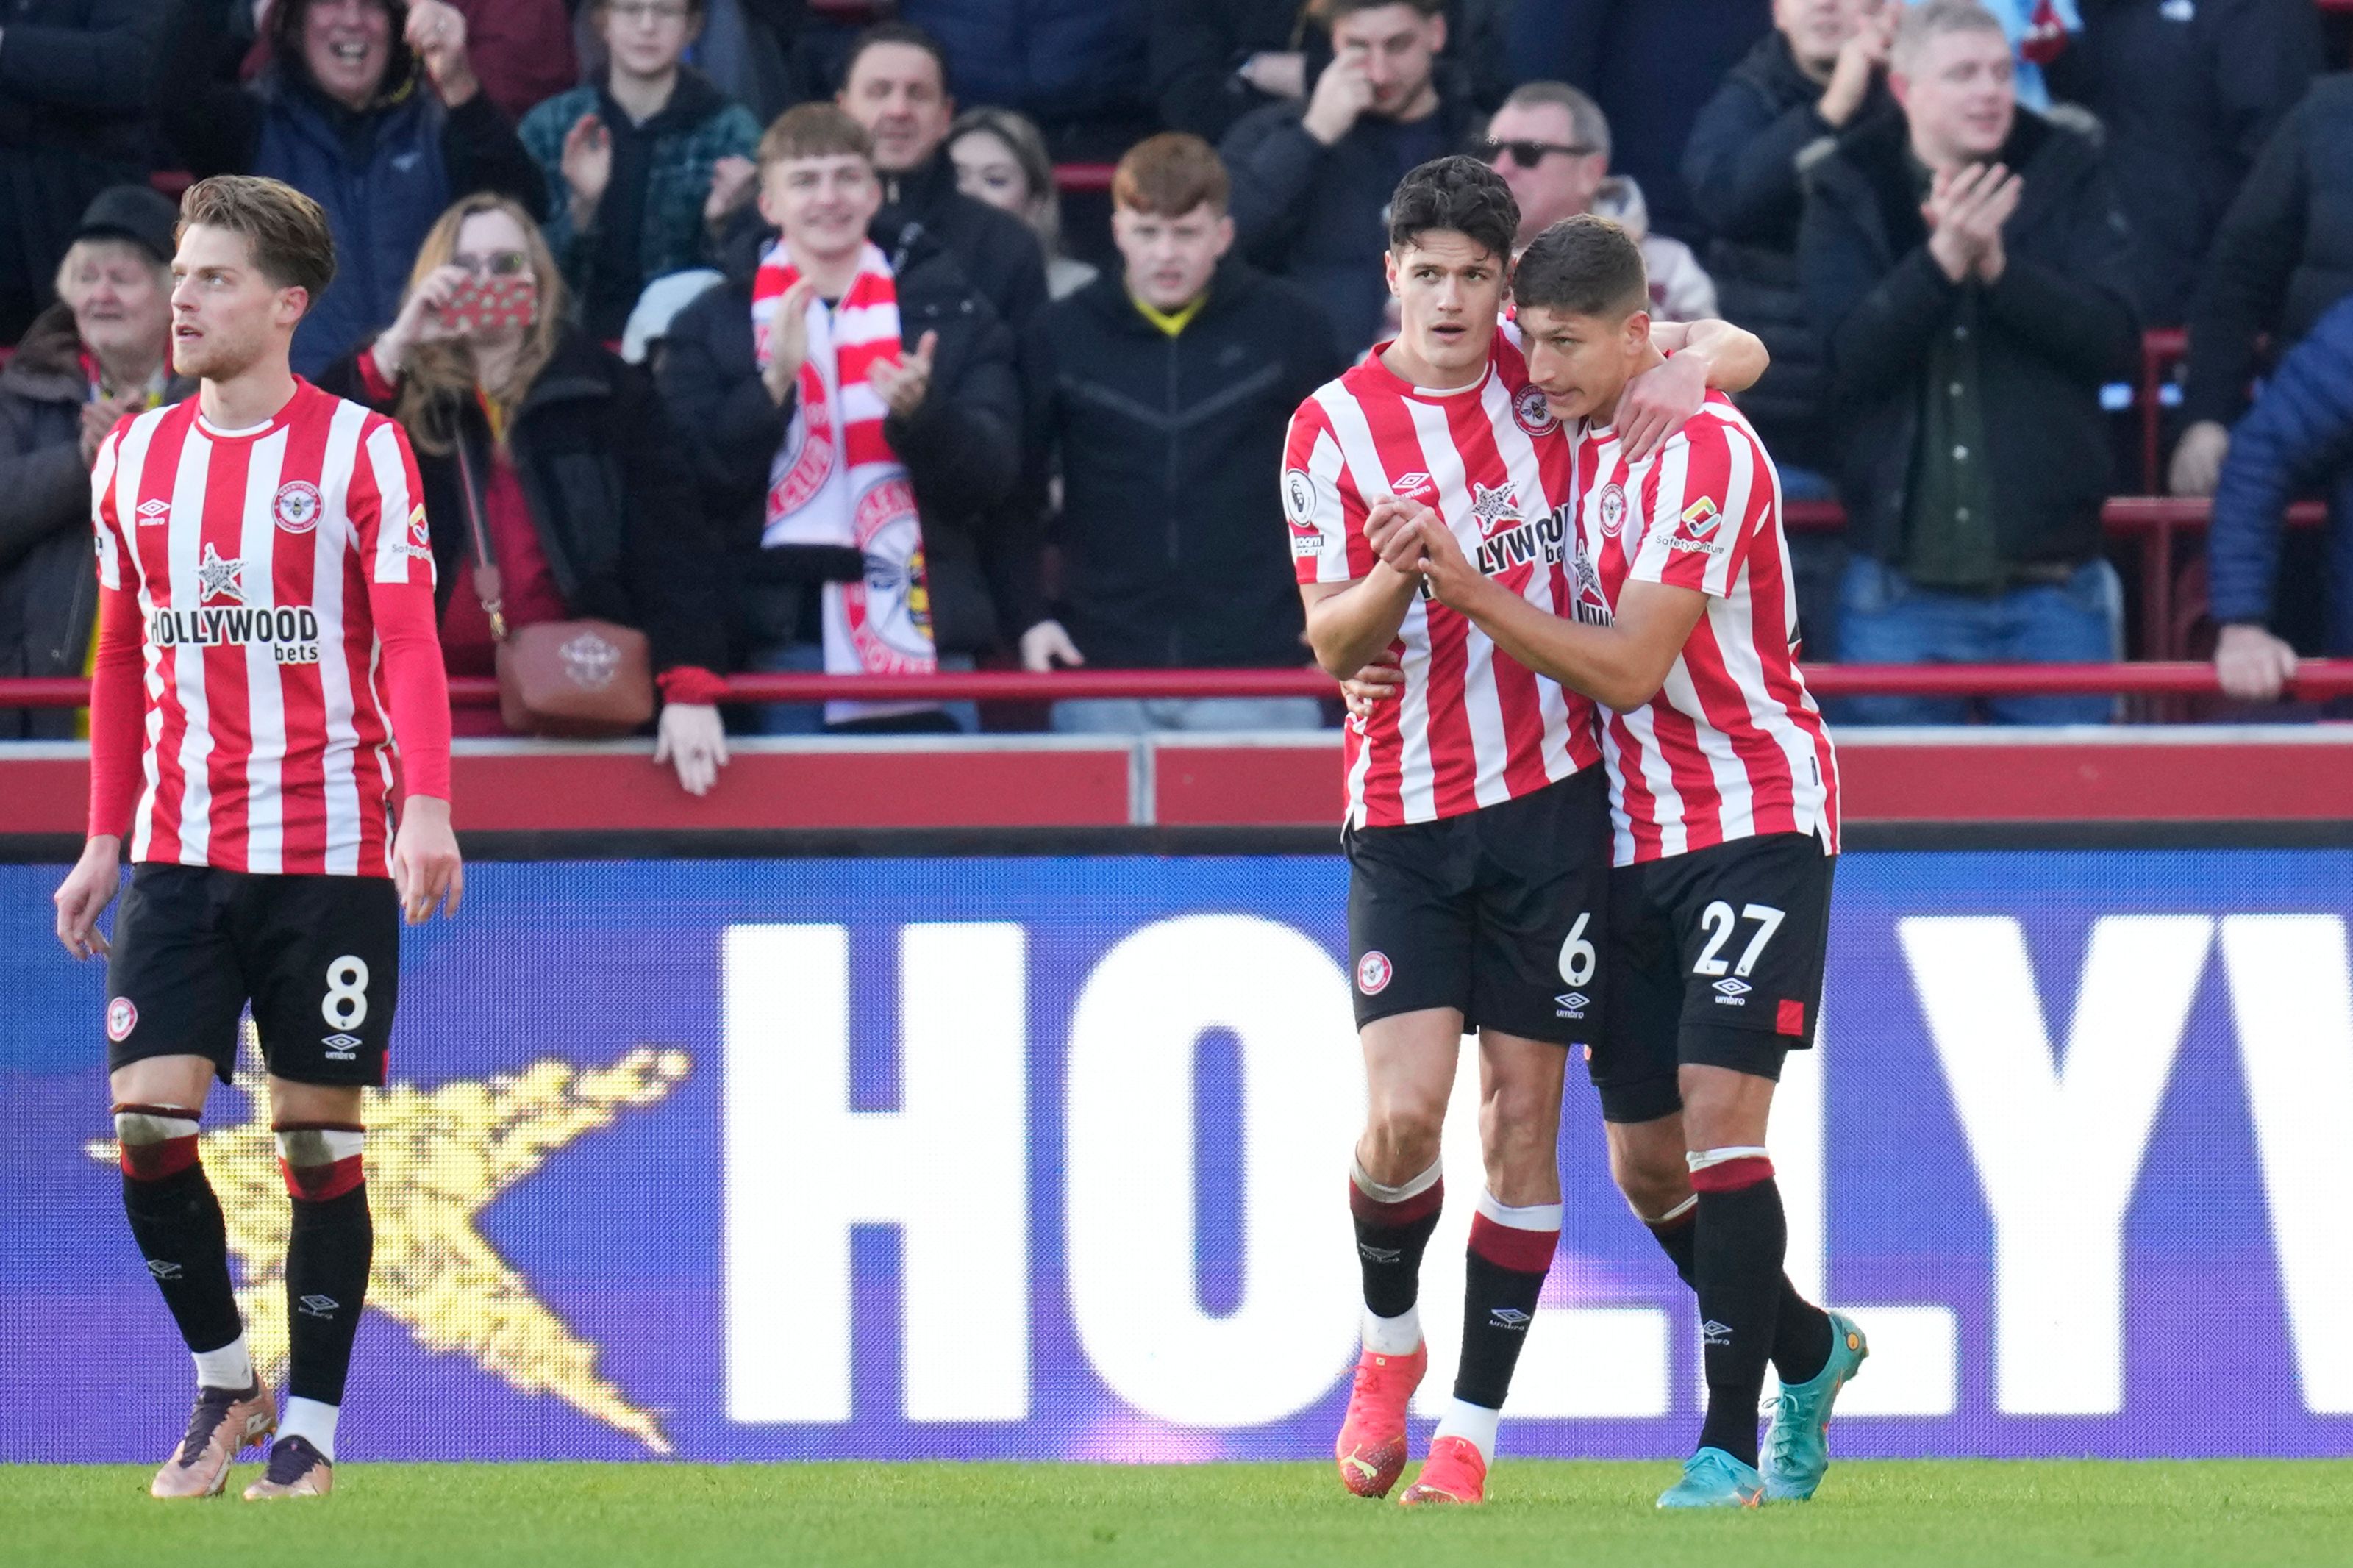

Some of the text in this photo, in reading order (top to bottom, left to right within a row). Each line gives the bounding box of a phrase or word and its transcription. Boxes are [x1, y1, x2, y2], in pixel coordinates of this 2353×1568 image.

[1476, 505, 1568, 575] LYWOO
[1544, 544, 1563, 563] be
[151, 609, 318, 644] HOLLYWOOD
[274, 643, 318, 661] bets
[1558, 912, 1596, 987] 6
[1693, 901, 1786, 977] 27
[321, 955, 369, 1031] 8
[1715, 995, 1746, 1006] umbro
[1556, 1009, 1584, 1019] umbro
[325, 1050, 356, 1060] umbro
